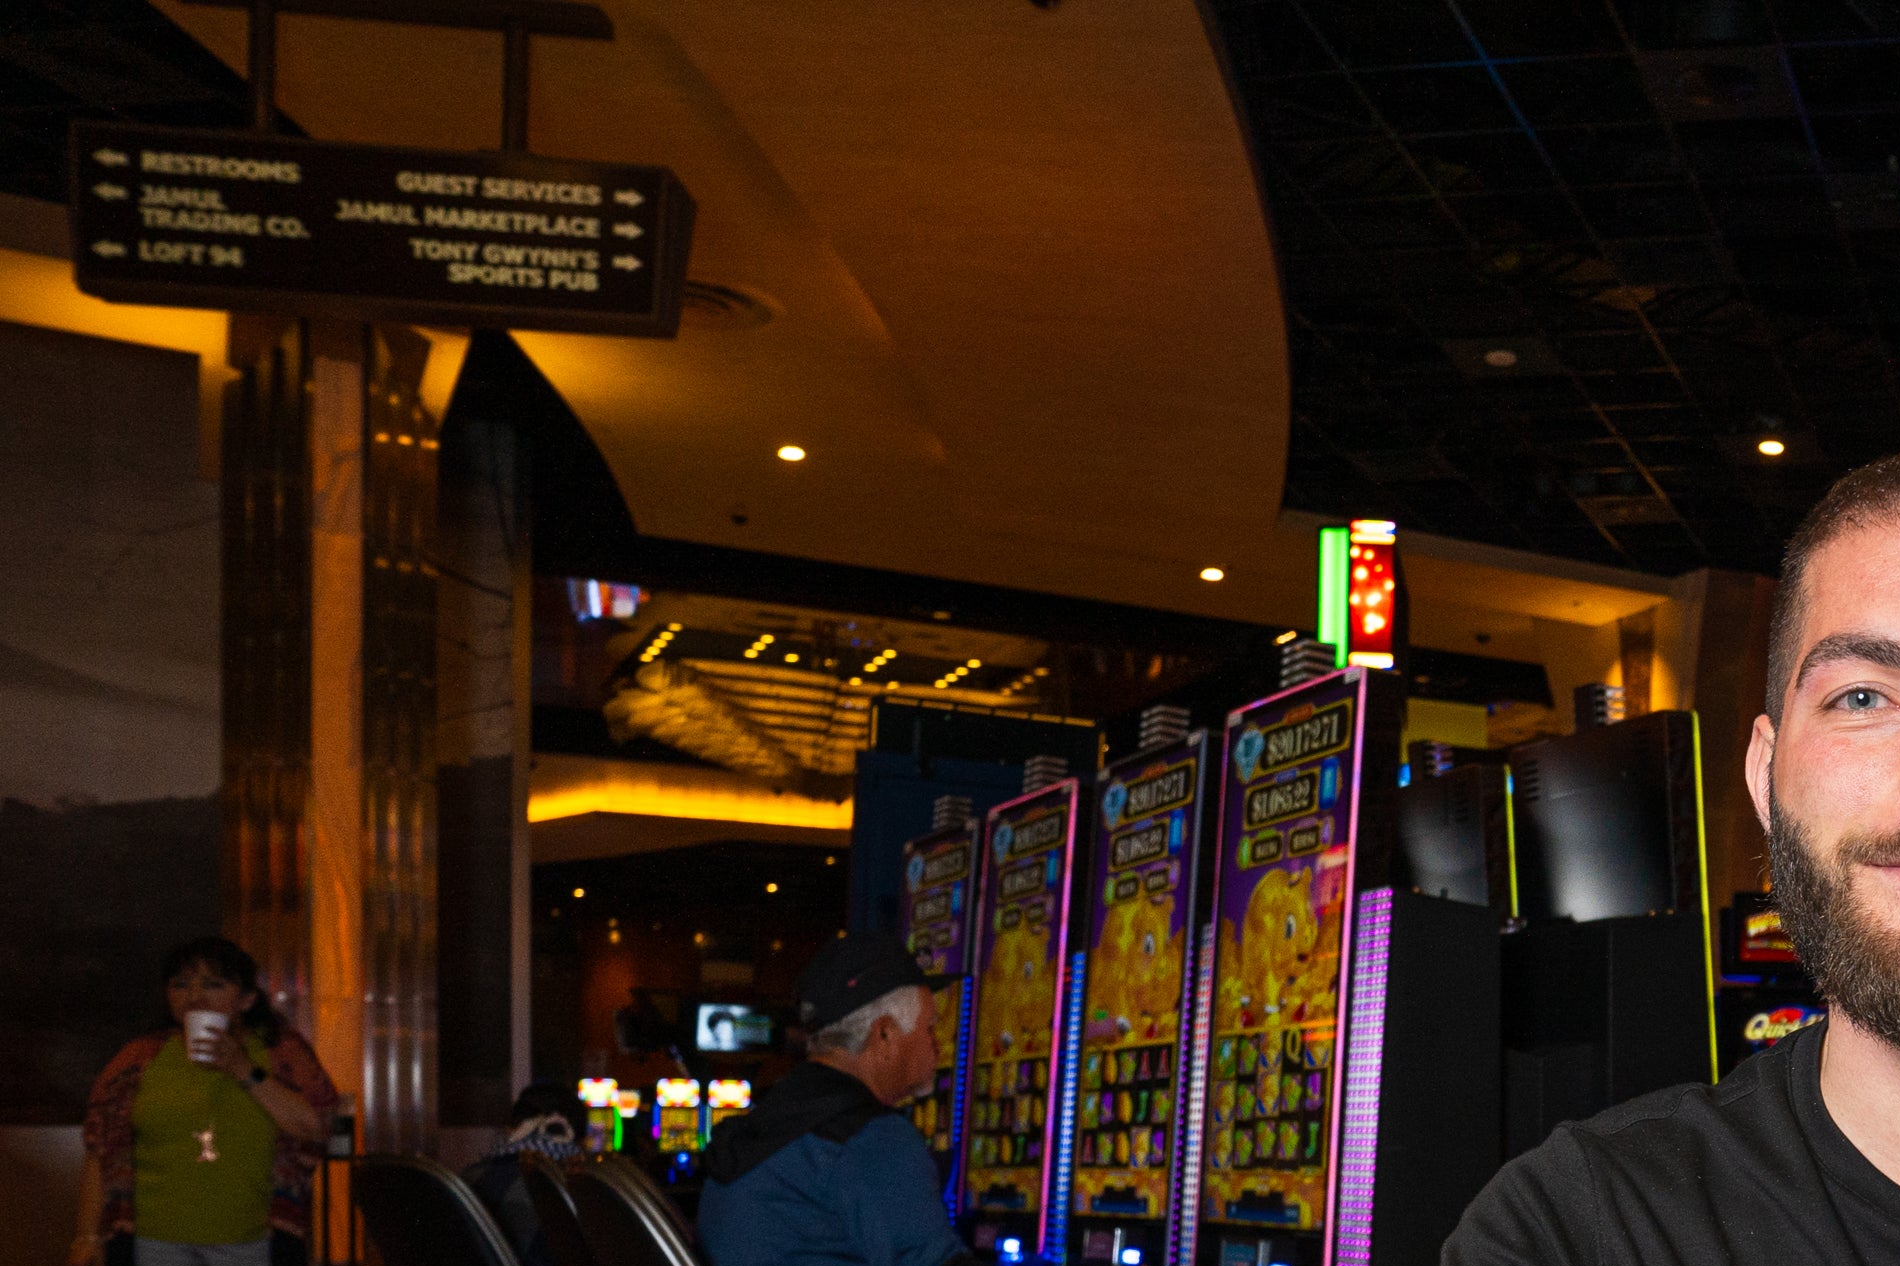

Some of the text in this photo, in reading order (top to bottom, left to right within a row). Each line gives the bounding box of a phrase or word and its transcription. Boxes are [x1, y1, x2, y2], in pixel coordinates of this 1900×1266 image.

[141, 151, 300, 184] RESTROOMS
[397, 171, 600, 206] GUEST SERVICES
[140, 206, 261, 236] TRADING
[335, 200, 600, 239] JAMUL MARKETPLACE
[138, 239, 205, 265] LOFT
[409, 237, 479, 262] TONY
[447, 262, 600, 292] SPORTS PUB
